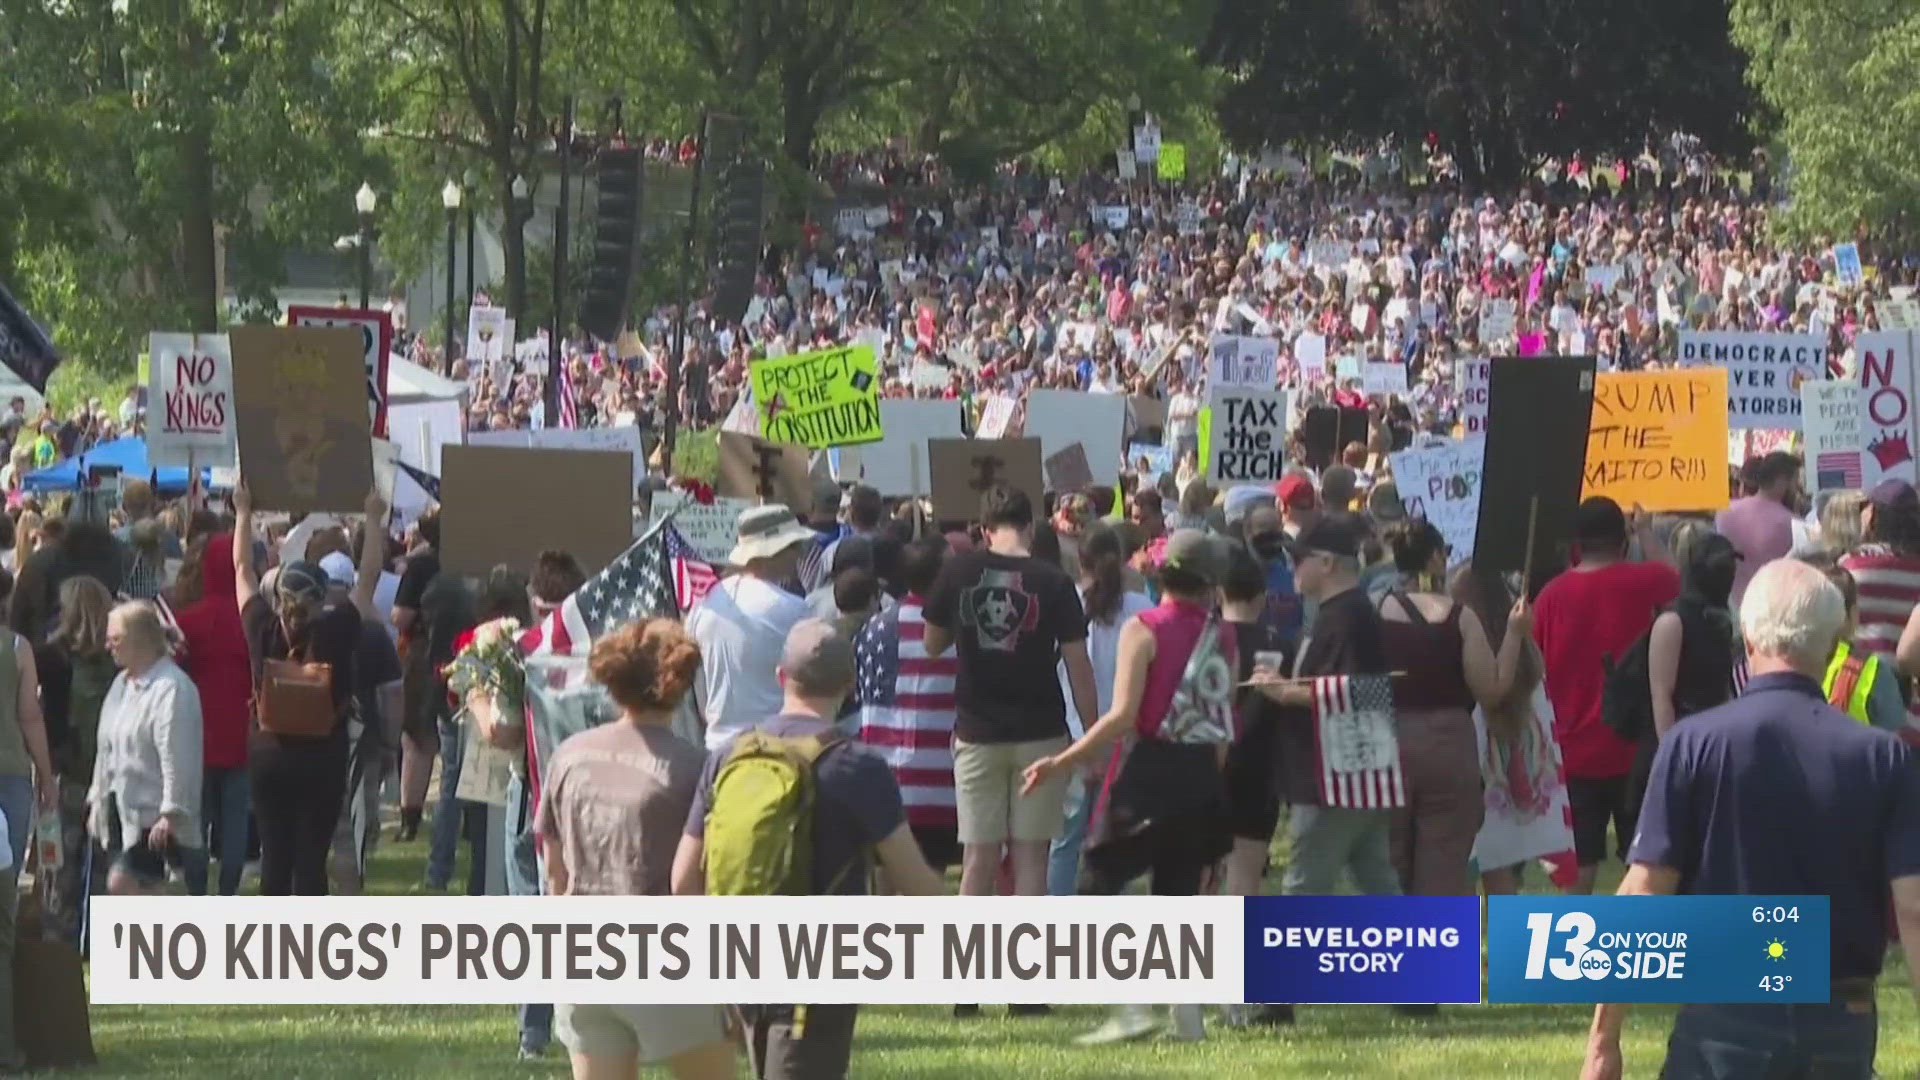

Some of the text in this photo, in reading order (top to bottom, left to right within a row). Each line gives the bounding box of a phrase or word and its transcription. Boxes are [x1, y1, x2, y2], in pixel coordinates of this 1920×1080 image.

[1684, 342, 1823, 364] DEMOCRACY
[176, 354, 215, 387] NO
[760, 350, 853, 395] PROTECT
[1733, 369, 1776, 387] VER
[794, 383, 832, 407] THE
[1594, 380, 1711, 416] RUMP
[1727, 397, 1801, 415] ATORSH
[766, 391, 881, 446] CONSTITUTION
[1222, 396, 1278, 427] TAX
[1223, 425, 1272, 451] the
[1590, 424, 1673, 449] THE
[1217, 449, 1283, 481] RICH
